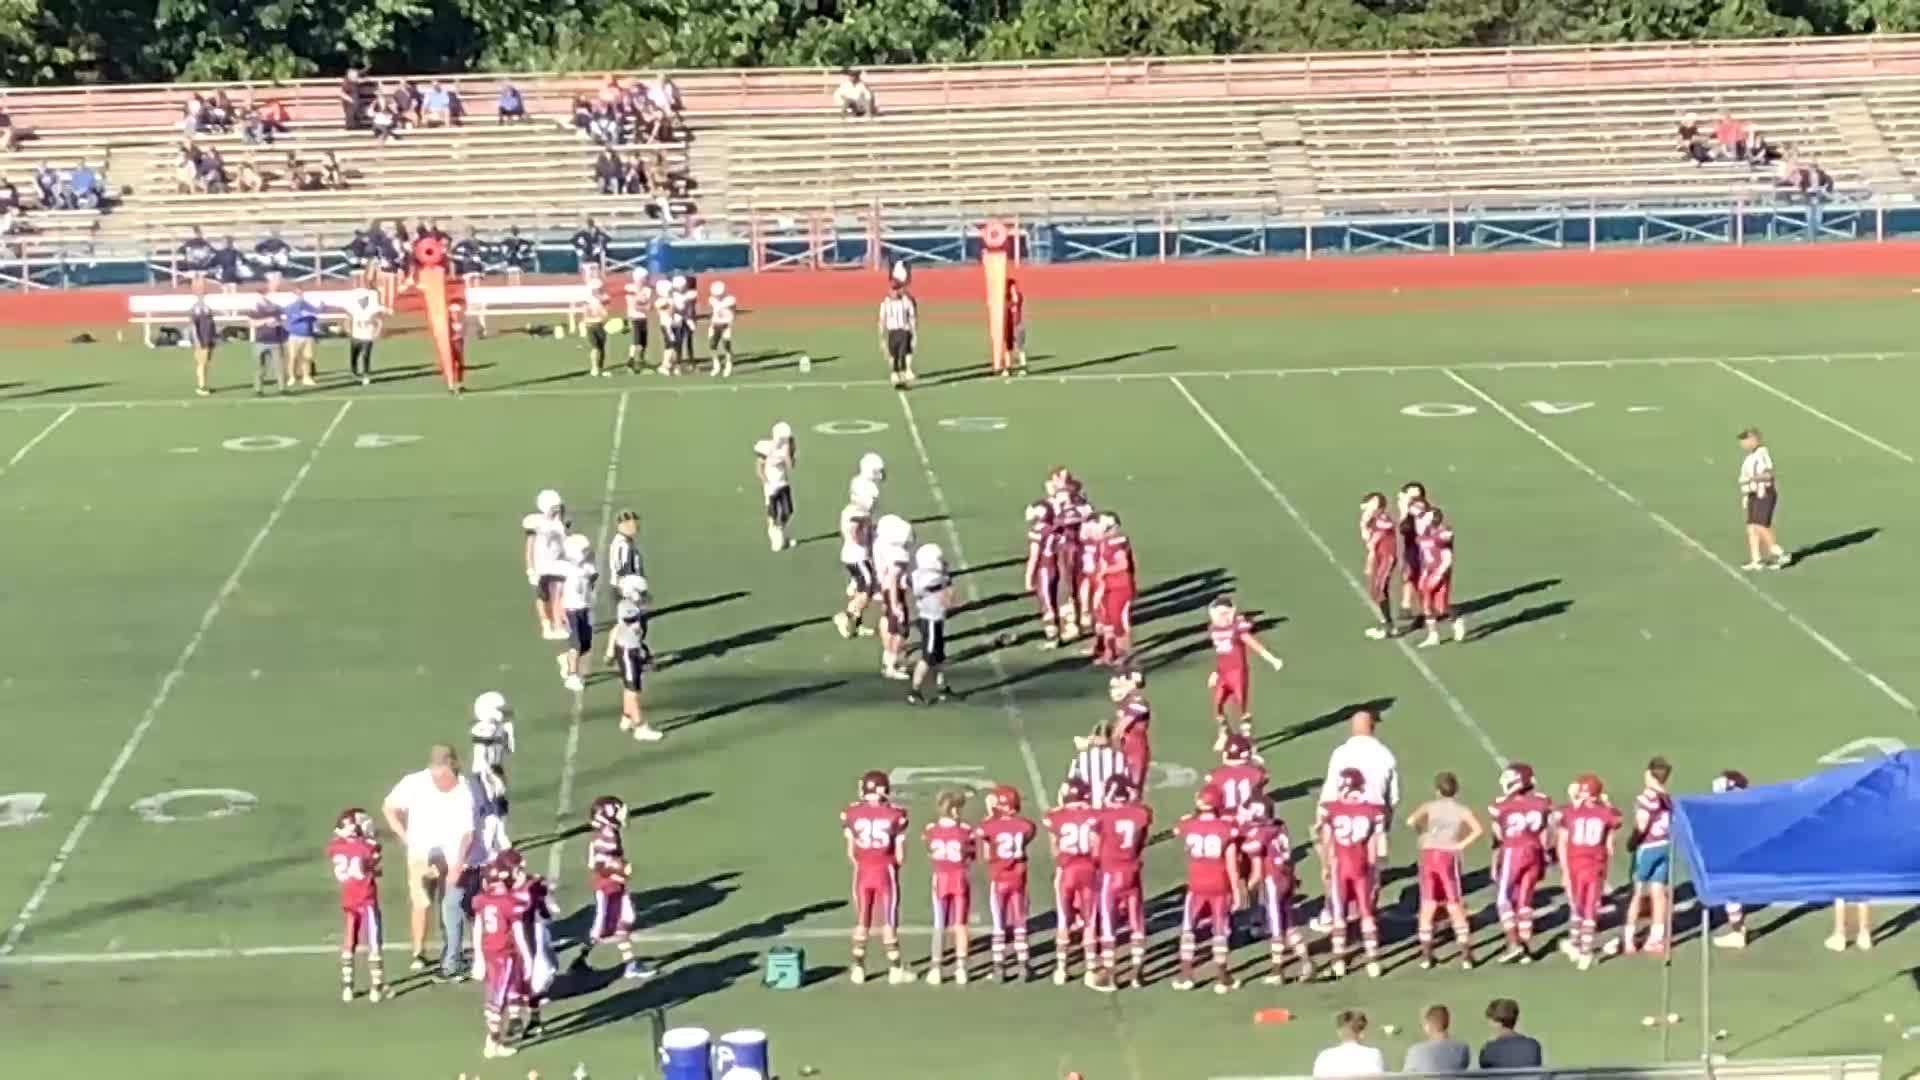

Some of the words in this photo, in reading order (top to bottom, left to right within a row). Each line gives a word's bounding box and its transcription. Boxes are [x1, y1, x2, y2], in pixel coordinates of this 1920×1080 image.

[854, 817, 892, 849] 35
[996, 832, 1024, 858] 21
[1115, 819, 1135, 848] 7
[333, 853, 364, 881] 24
